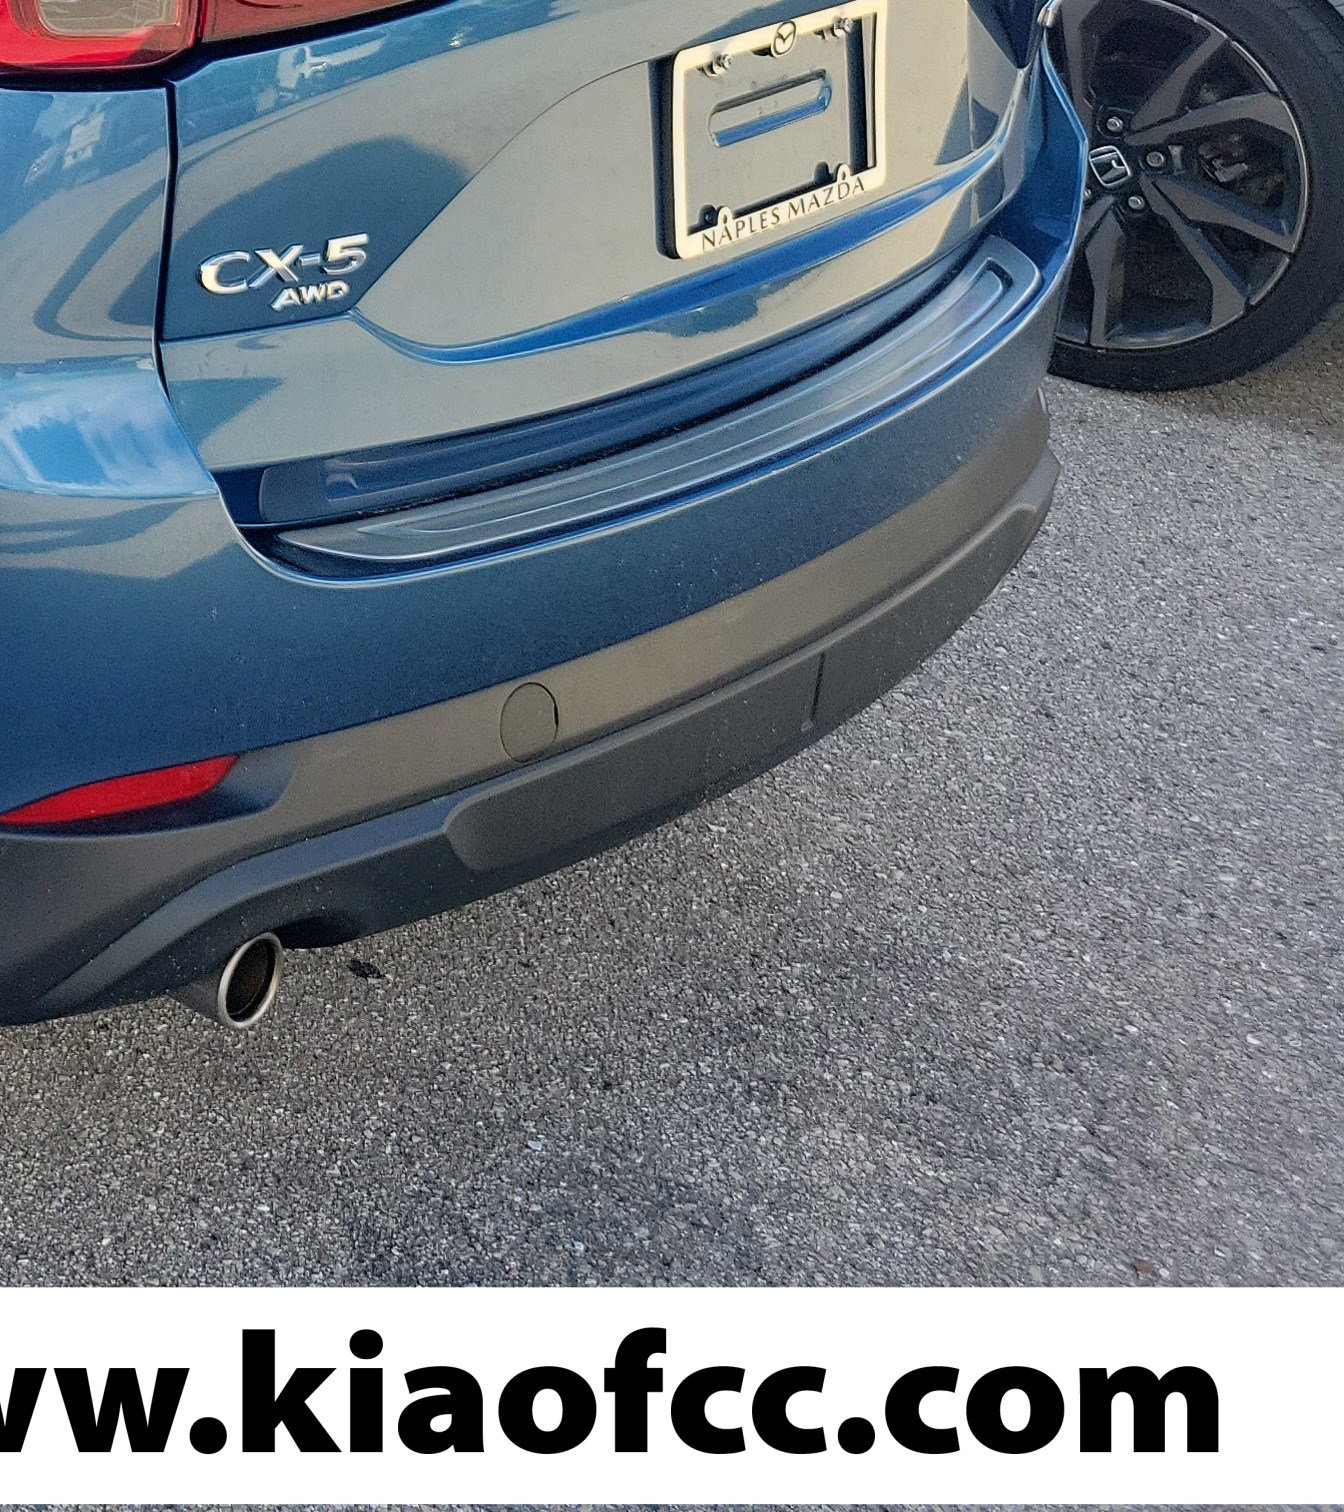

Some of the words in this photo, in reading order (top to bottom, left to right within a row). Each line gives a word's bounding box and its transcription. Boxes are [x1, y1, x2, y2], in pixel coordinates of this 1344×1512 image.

[701, 206, 781, 251] NAPLES
[787, 176, 865, 221] MAZDA
[199, 232, 370, 295] CX-5
[270, 279, 350, 312] AWD
